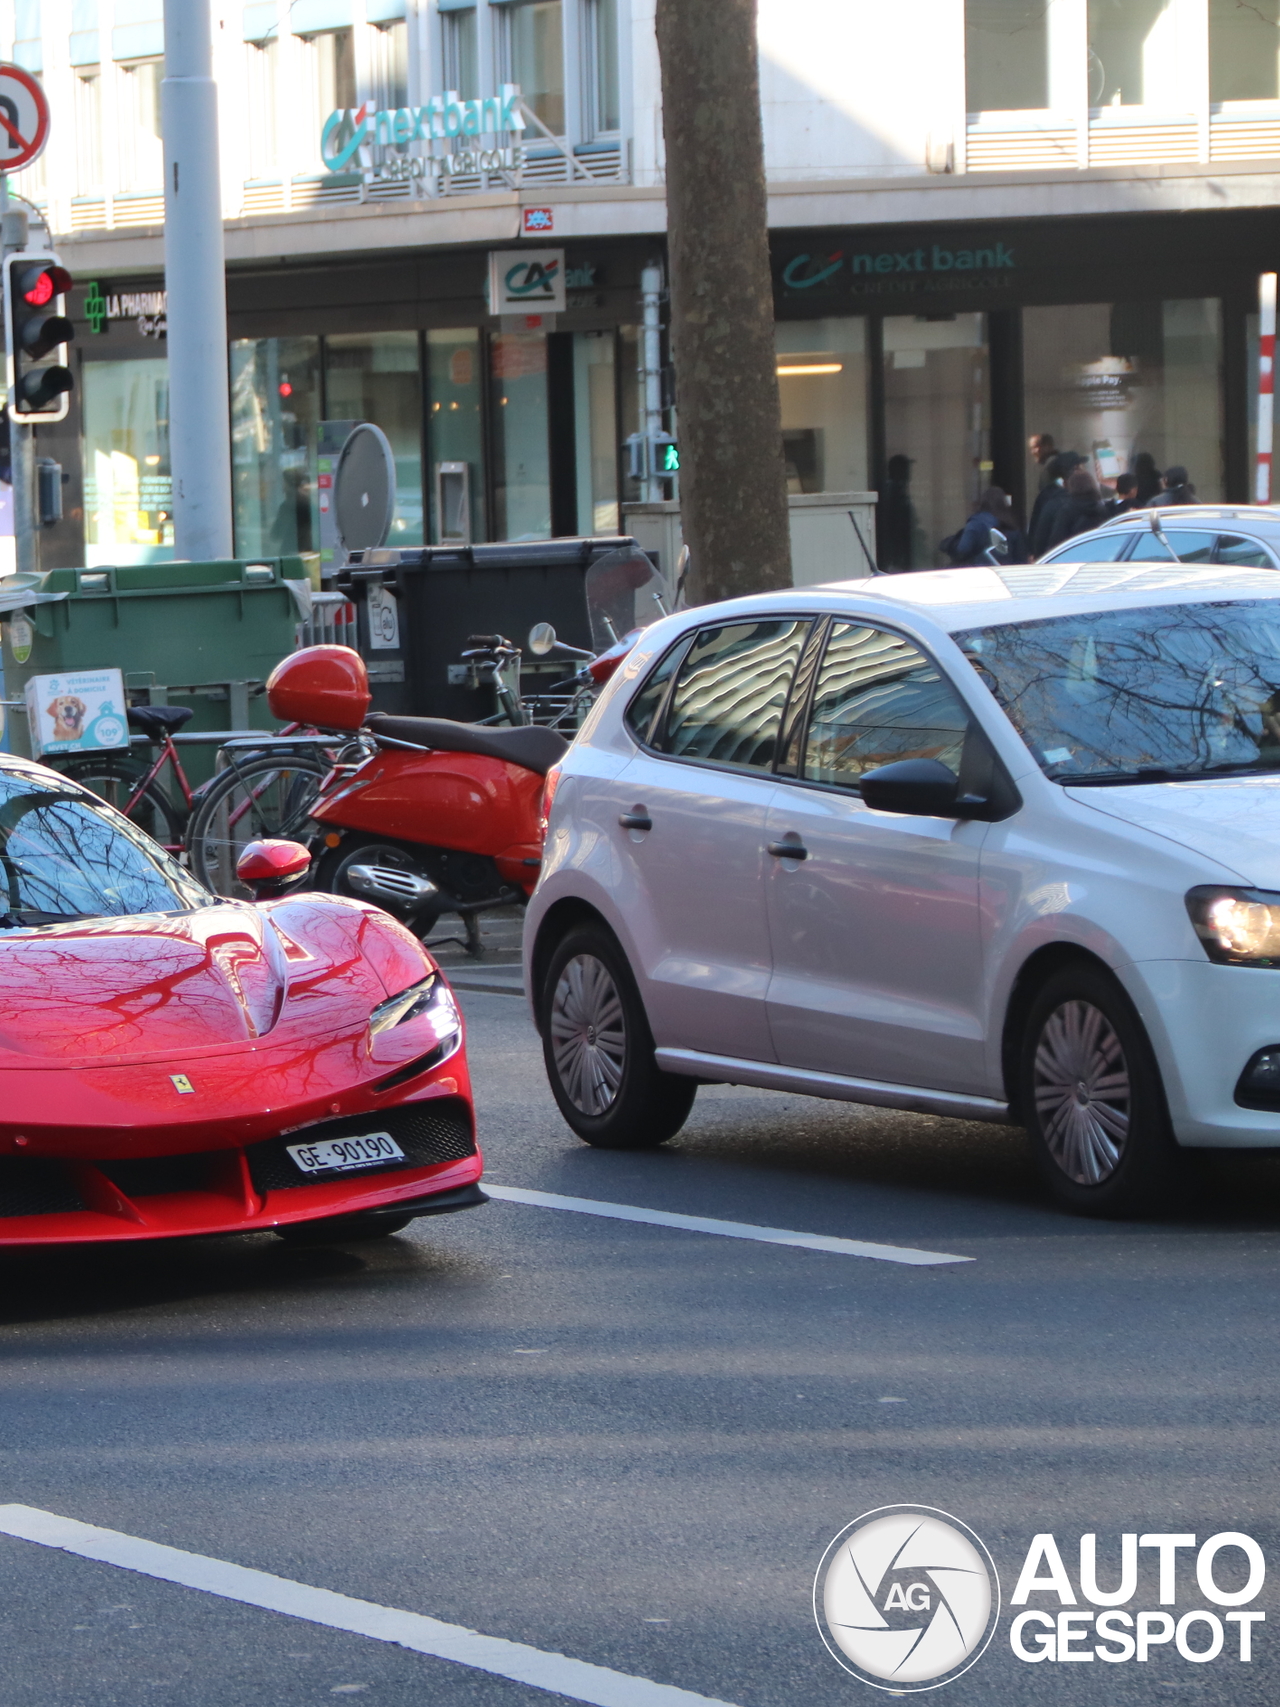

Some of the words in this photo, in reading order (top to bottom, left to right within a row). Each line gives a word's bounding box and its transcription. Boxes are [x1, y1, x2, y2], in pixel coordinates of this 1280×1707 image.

[376, 96, 441, 145] next
[443, 84, 524, 138] bank
[442, 148, 526, 176] AGRICOLE
[852, 249, 926, 274] next
[932, 242, 1016, 271] bank
[565, 262, 596, 288] ank
[106, 295, 120, 318] LA
[66, 675, 110, 685] VÉTÉRINAIRE
[74, 685, 106, 694] DOMICILE
[101, 728, 118, 737] 109
